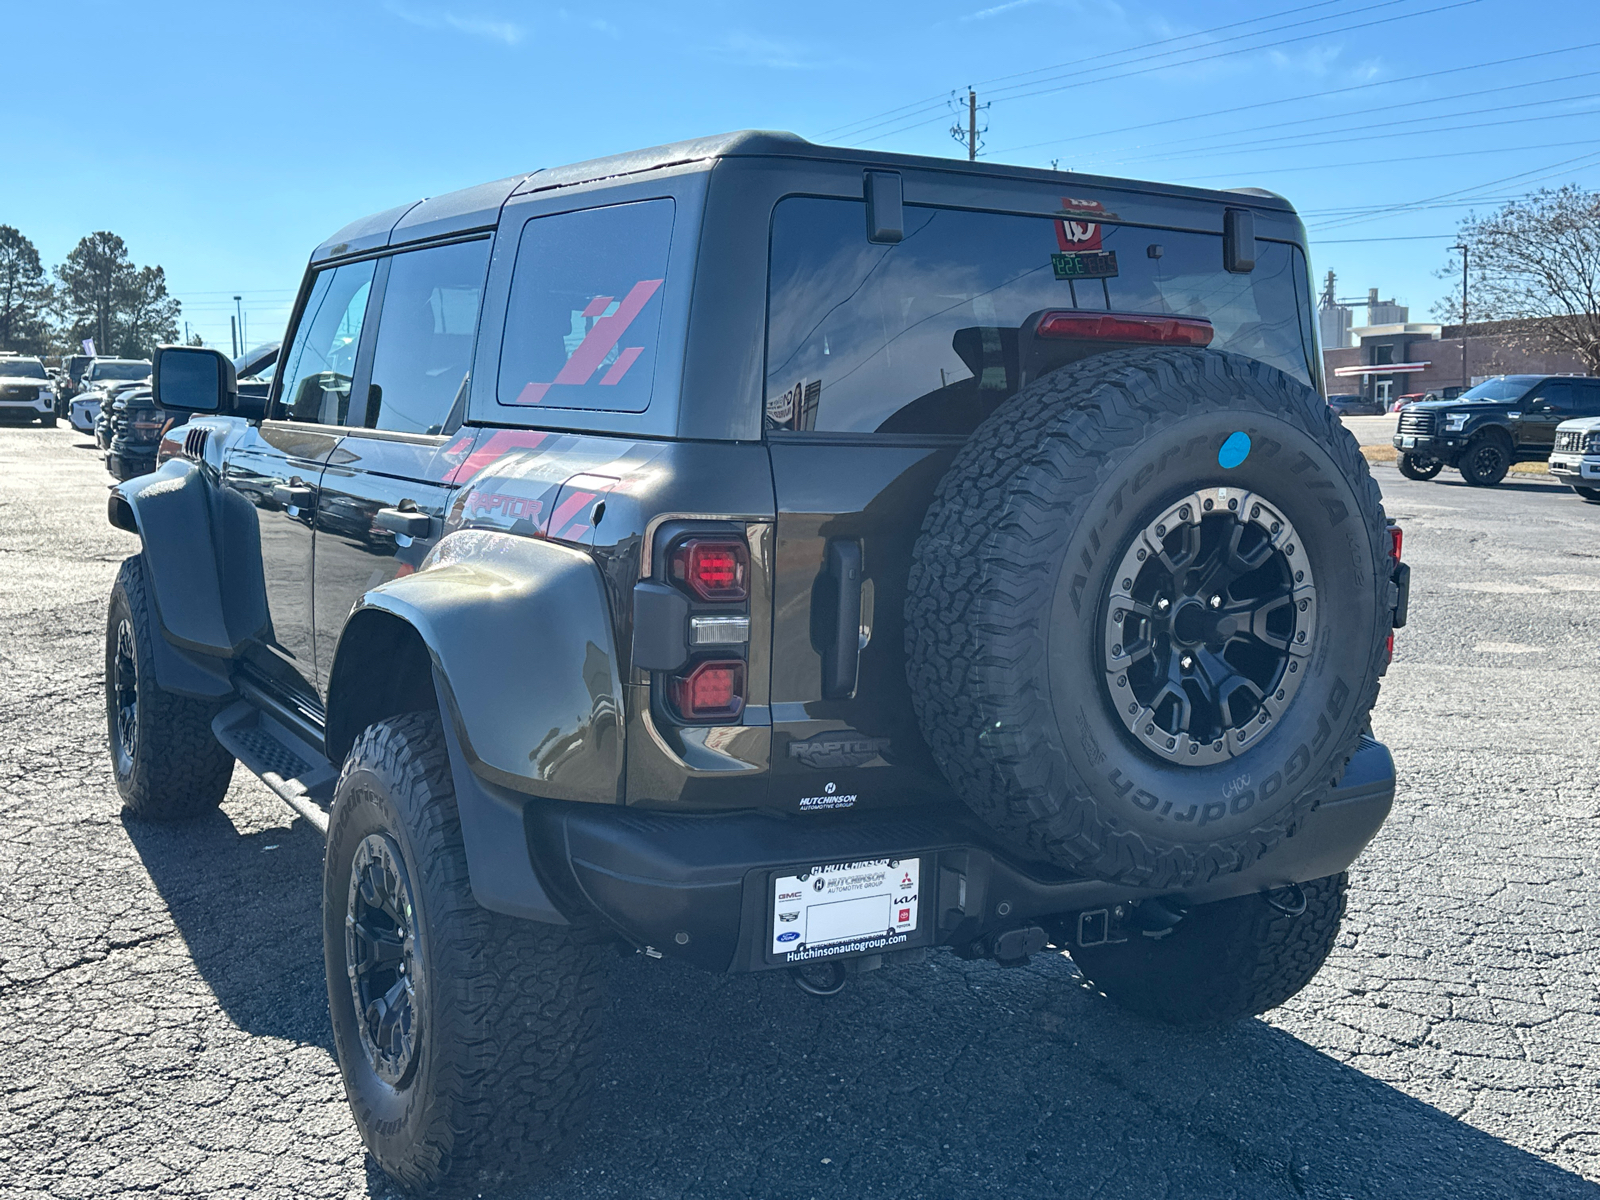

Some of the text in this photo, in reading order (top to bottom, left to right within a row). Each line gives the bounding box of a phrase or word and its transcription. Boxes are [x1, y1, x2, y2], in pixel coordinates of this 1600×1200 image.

[463, 491, 544, 533] RAPTOR
[1069, 428, 1282, 618] All-Terrn
[787, 739, 893, 765] RAPTOR
[1107, 675, 1350, 827] BFGoodrich
[800, 795, 857, 805] HUTCHINSON
[778, 891, 802, 900] GMC
[828, 881, 883, 894] AUTOMOTIVE GROUP
[787, 934, 907, 963] Hutchinsonautogroup.com
